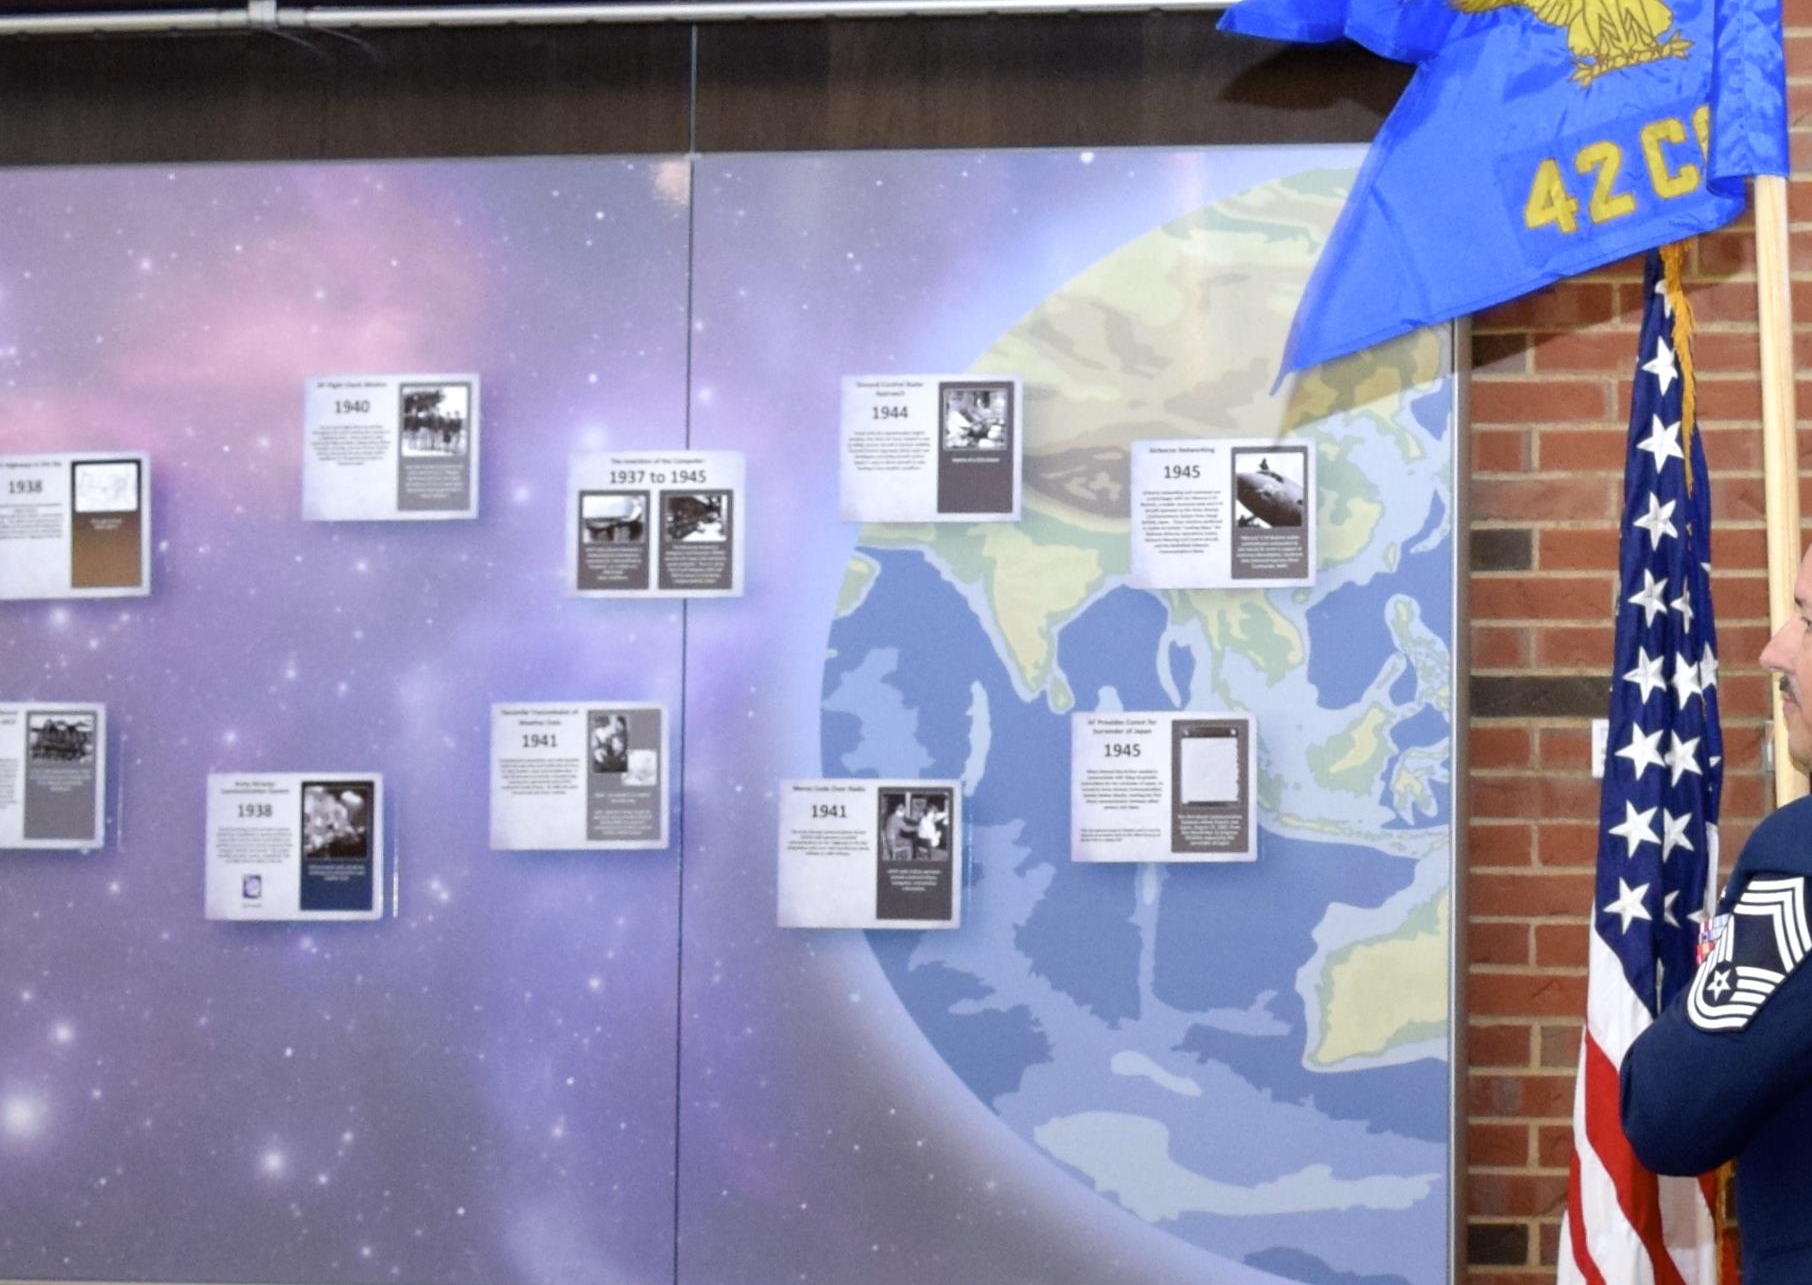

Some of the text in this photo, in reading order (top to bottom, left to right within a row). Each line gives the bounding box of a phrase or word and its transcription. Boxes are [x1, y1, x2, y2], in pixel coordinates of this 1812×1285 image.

[1523, 102, 1710, 235] 42 C
[334, 399, 370, 415] 1940
[872, 405, 909, 420] 1944
[609, 469, 707, 485] 1937 to 1945
[1163, 464, 1202, 480] 1945
[8, 479, 43, 495] 1938
[522, 733, 558, 749] 1941
[1103, 742, 1142, 758] 1945
[238, 803, 273, 819] 1938
[810, 803, 848, 819] 1941
